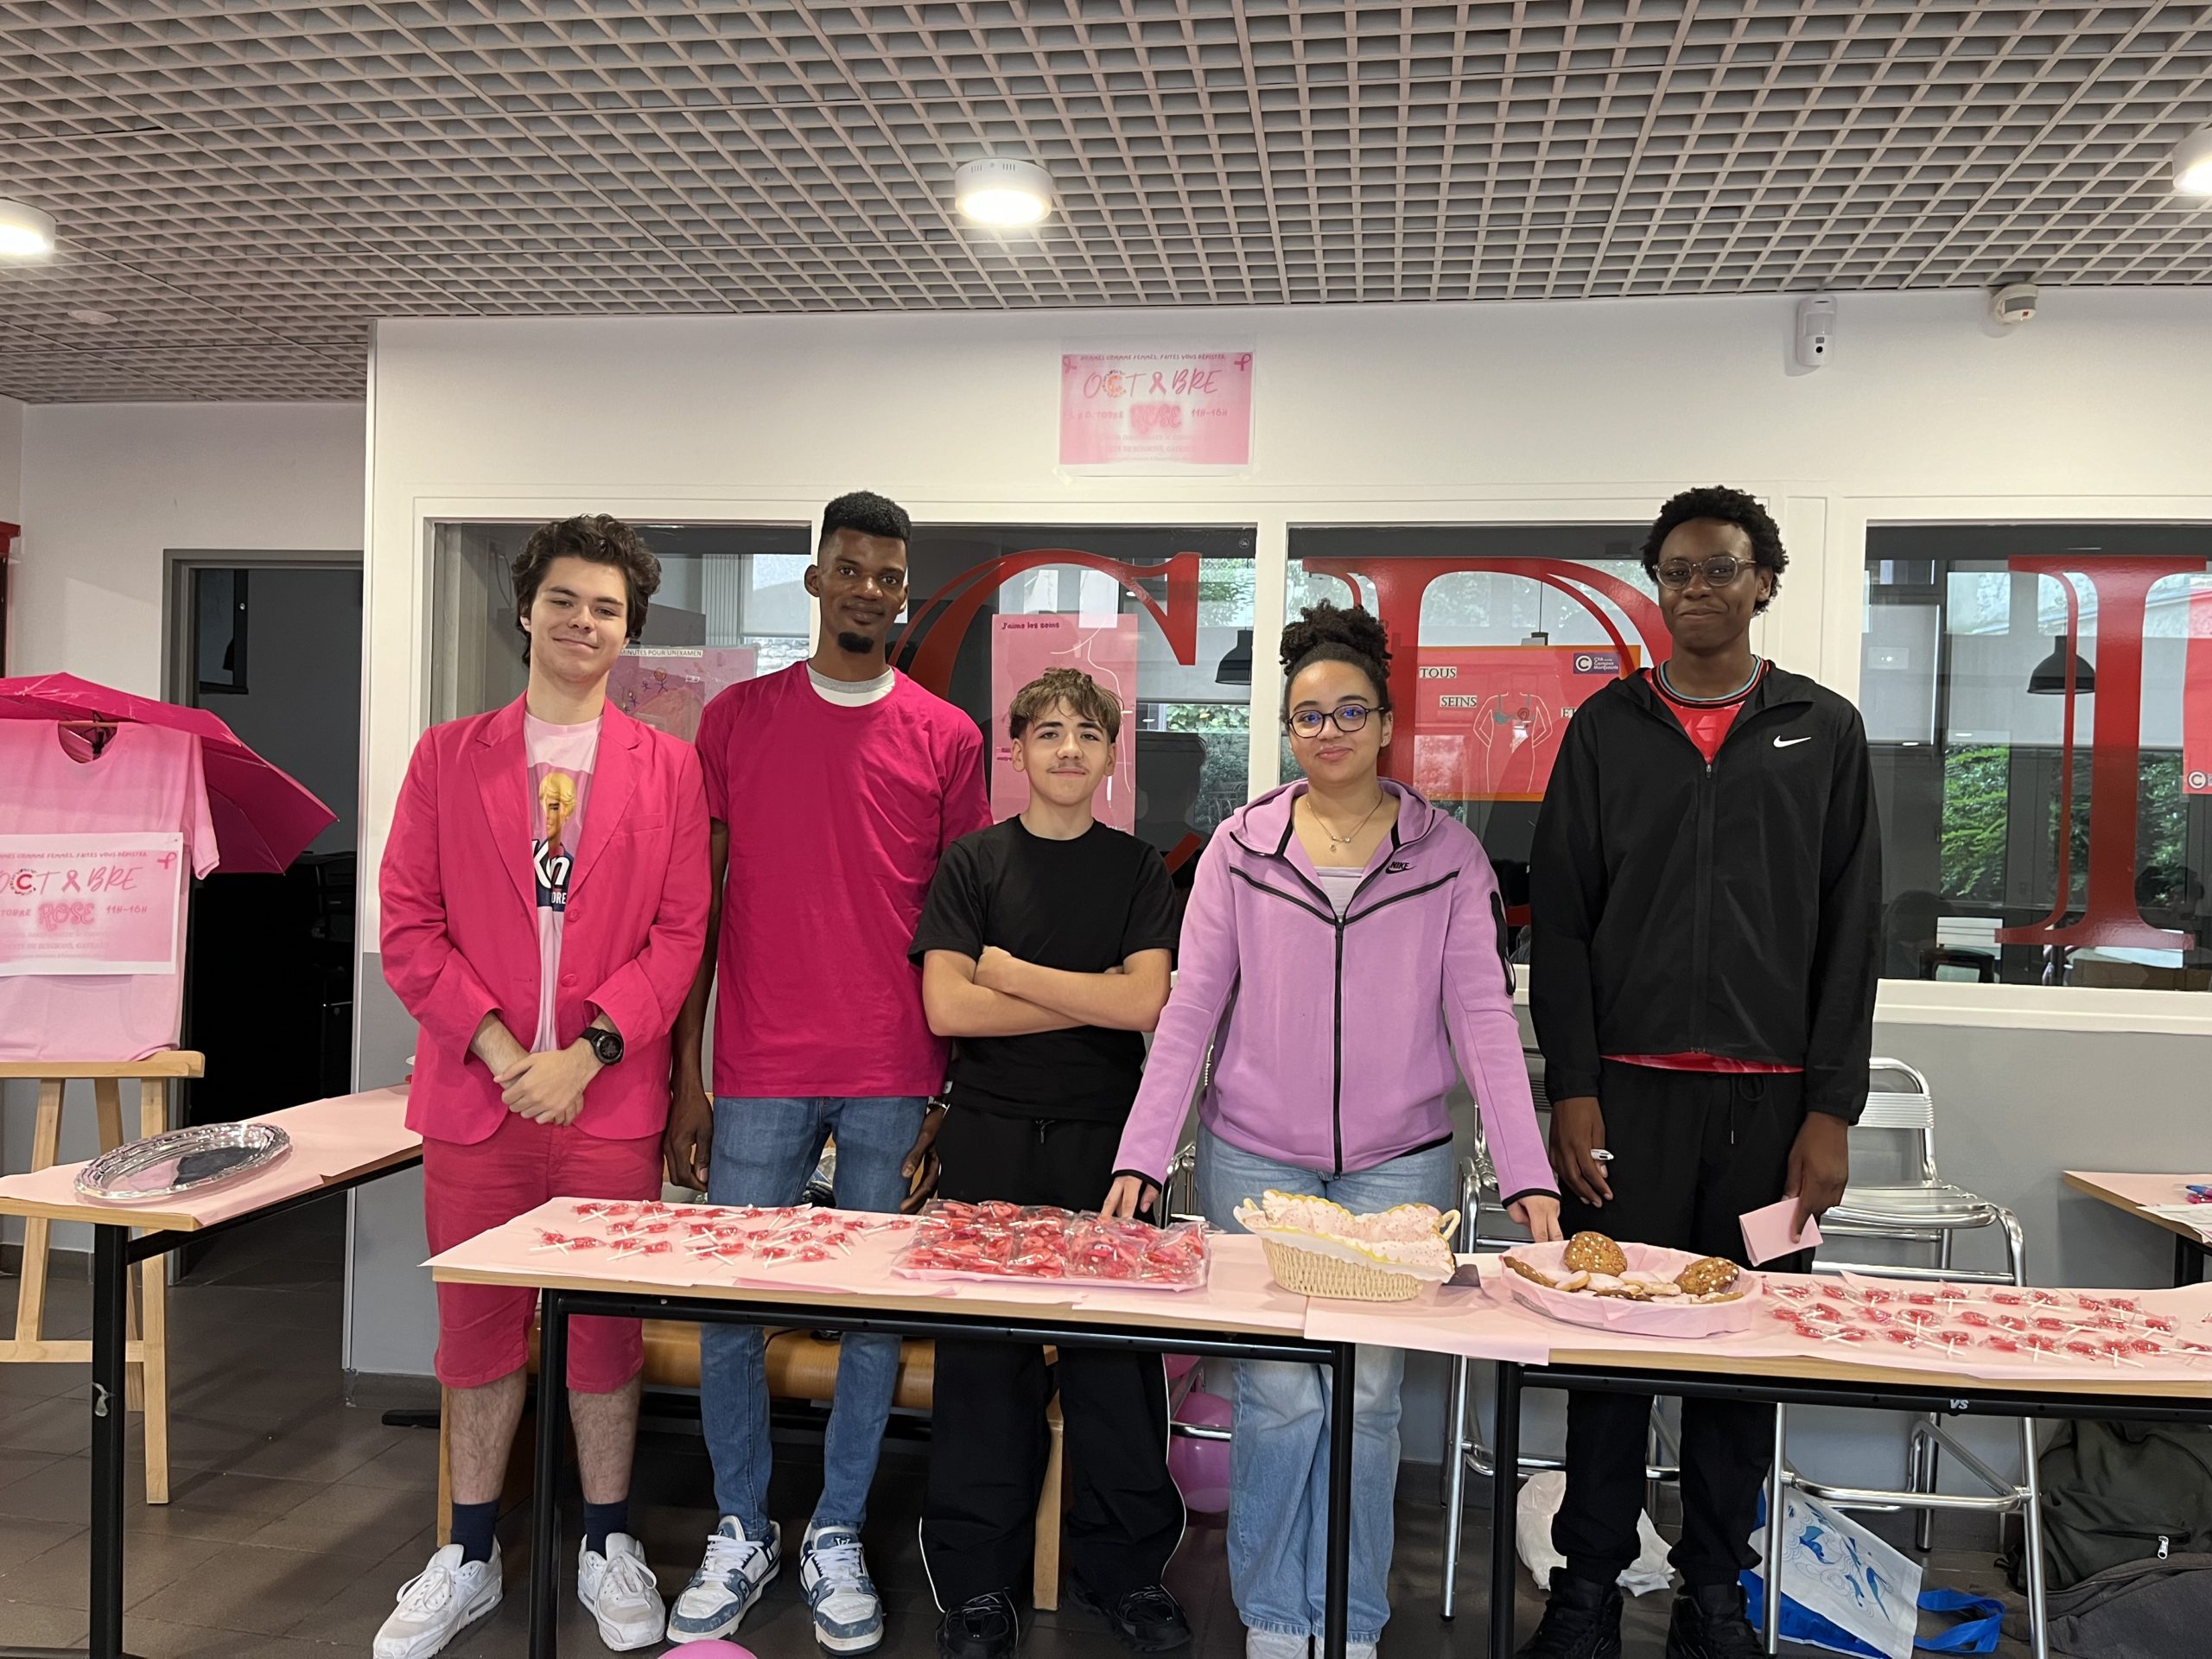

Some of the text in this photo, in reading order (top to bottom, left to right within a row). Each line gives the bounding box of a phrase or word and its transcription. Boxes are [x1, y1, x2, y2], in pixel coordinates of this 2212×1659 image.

[1420, 668, 1457, 678] TOUS
[1440, 696, 1478, 708] SEINS
[1389, 861, 1410, 870] NIKE
[105, 905, 148, 914] 11H-16H
[38, 901, 95, 932] ROSE
[1949, 1399, 1969, 1410] VS
